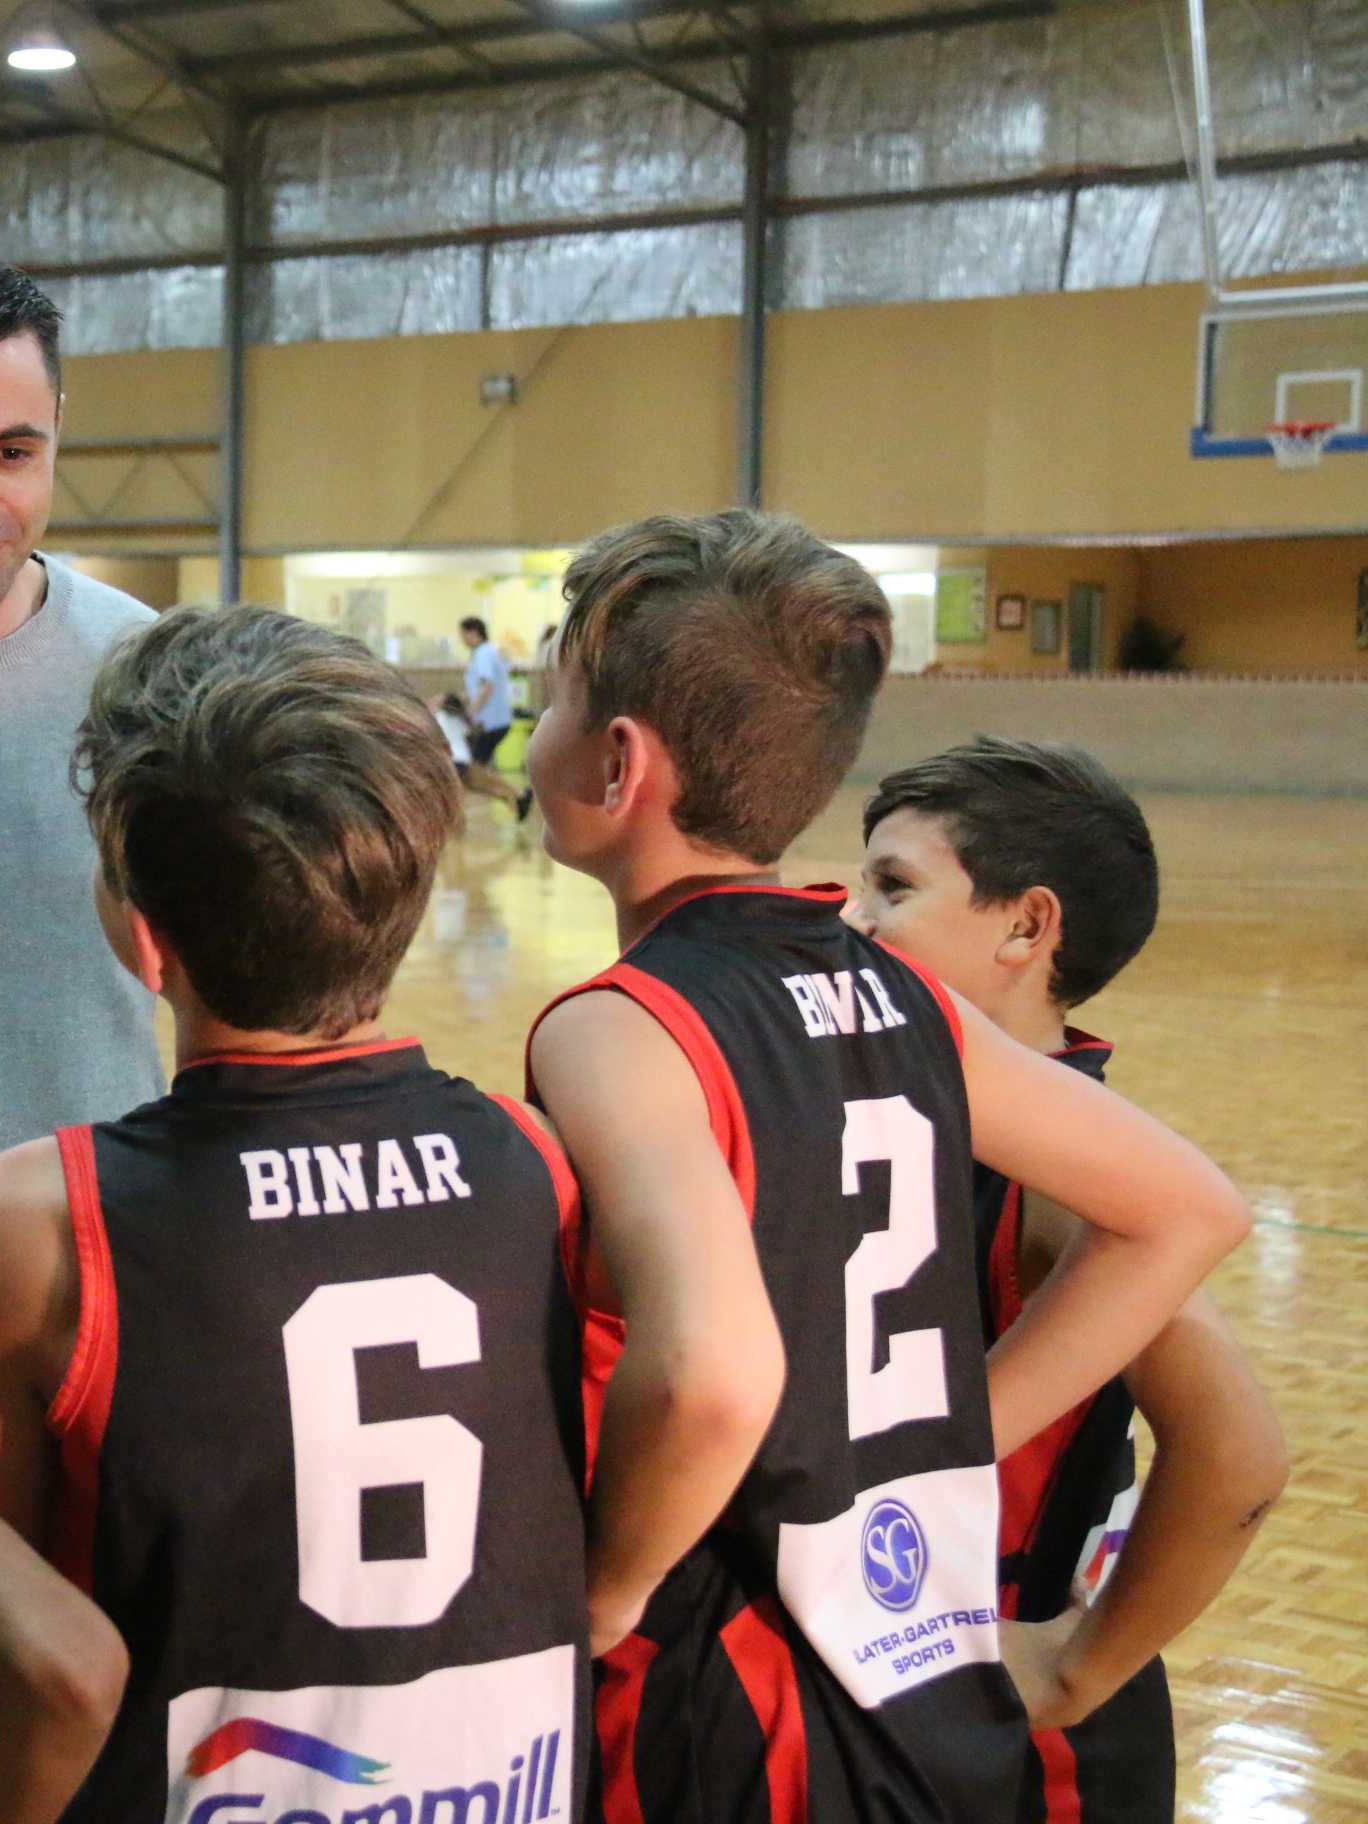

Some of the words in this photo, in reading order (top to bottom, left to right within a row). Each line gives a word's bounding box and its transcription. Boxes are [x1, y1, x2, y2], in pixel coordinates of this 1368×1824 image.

[239, 1132, 472, 1221] BINAR
[841, 1095, 950, 1442] 2
[281, 1272, 484, 1629] 6
[891, 1638, 956, 1676] SPORTS
